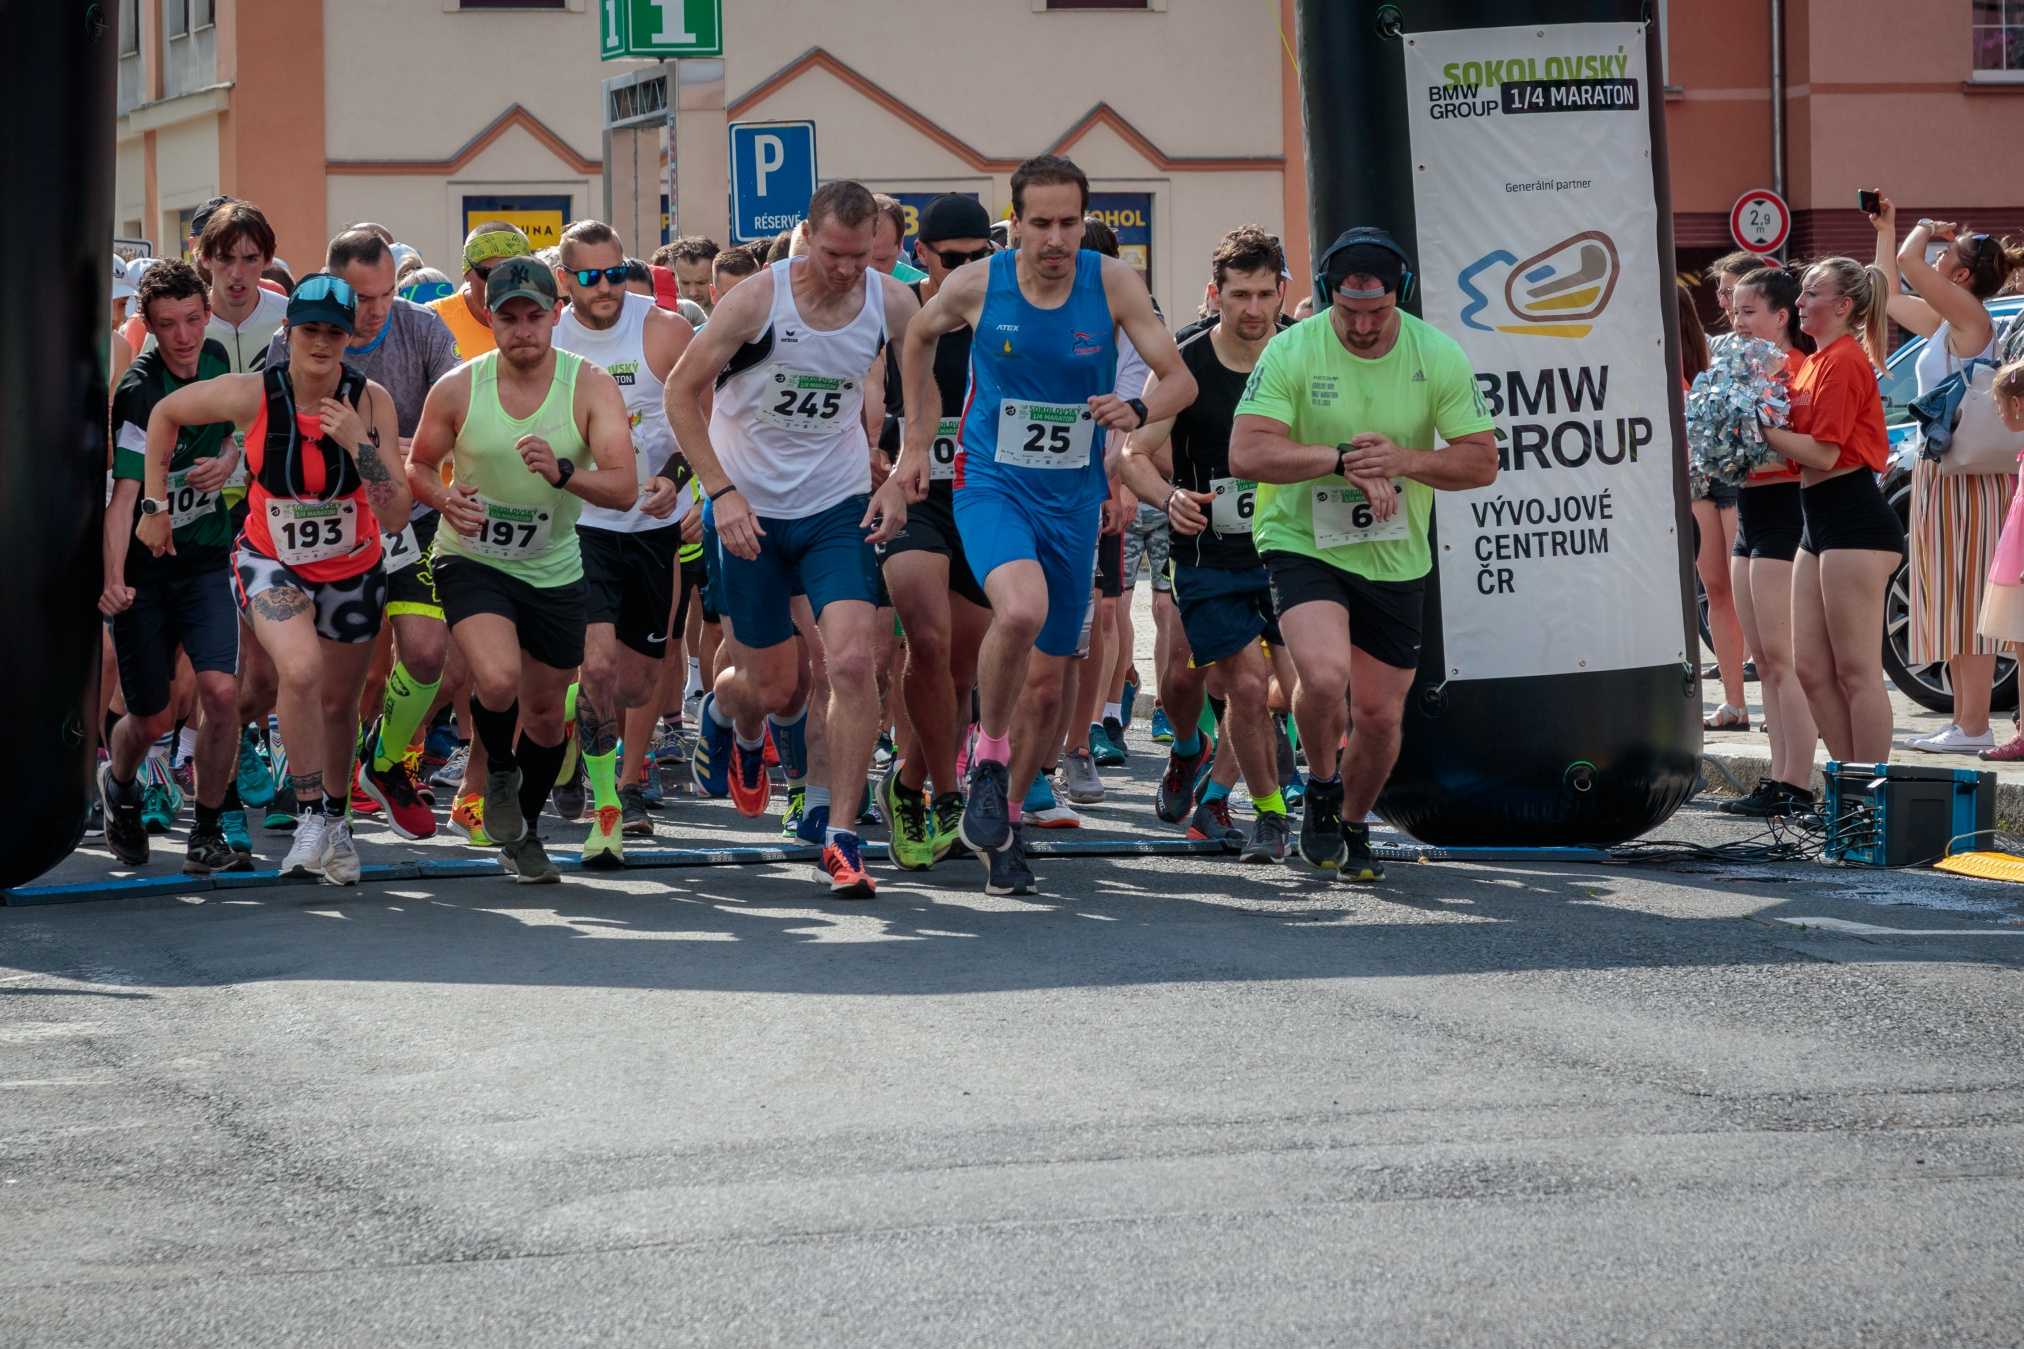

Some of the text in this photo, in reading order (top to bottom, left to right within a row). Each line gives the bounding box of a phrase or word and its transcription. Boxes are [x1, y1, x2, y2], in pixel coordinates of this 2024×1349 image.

[1443, 45, 1629, 88] SOKOLOVSKÝ
[1428, 84, 1479, 101] BMW
[1510, 85, 1635, 108] 1/4 MARATON
[1430, 100, 1499, 120] GROUP
[754, 134, 785, 197] P
[1505, 178, 1592, 193] Generální partner
[1084, 209, 1147, 227] OHOL
[774, 390, 842, 419] 245
[1023, 423, 1071, 454] 25
[1471, 488, 1613, 528] VÝVOJOVÉ
[282, 518, 343, 550] 193
[381, 532, 409, 559] 2
[478, 519, 538, 548] 197
[1474, 527, 1609, 562] CENTRUM
[1477, 563, 1516, 595] ČR
